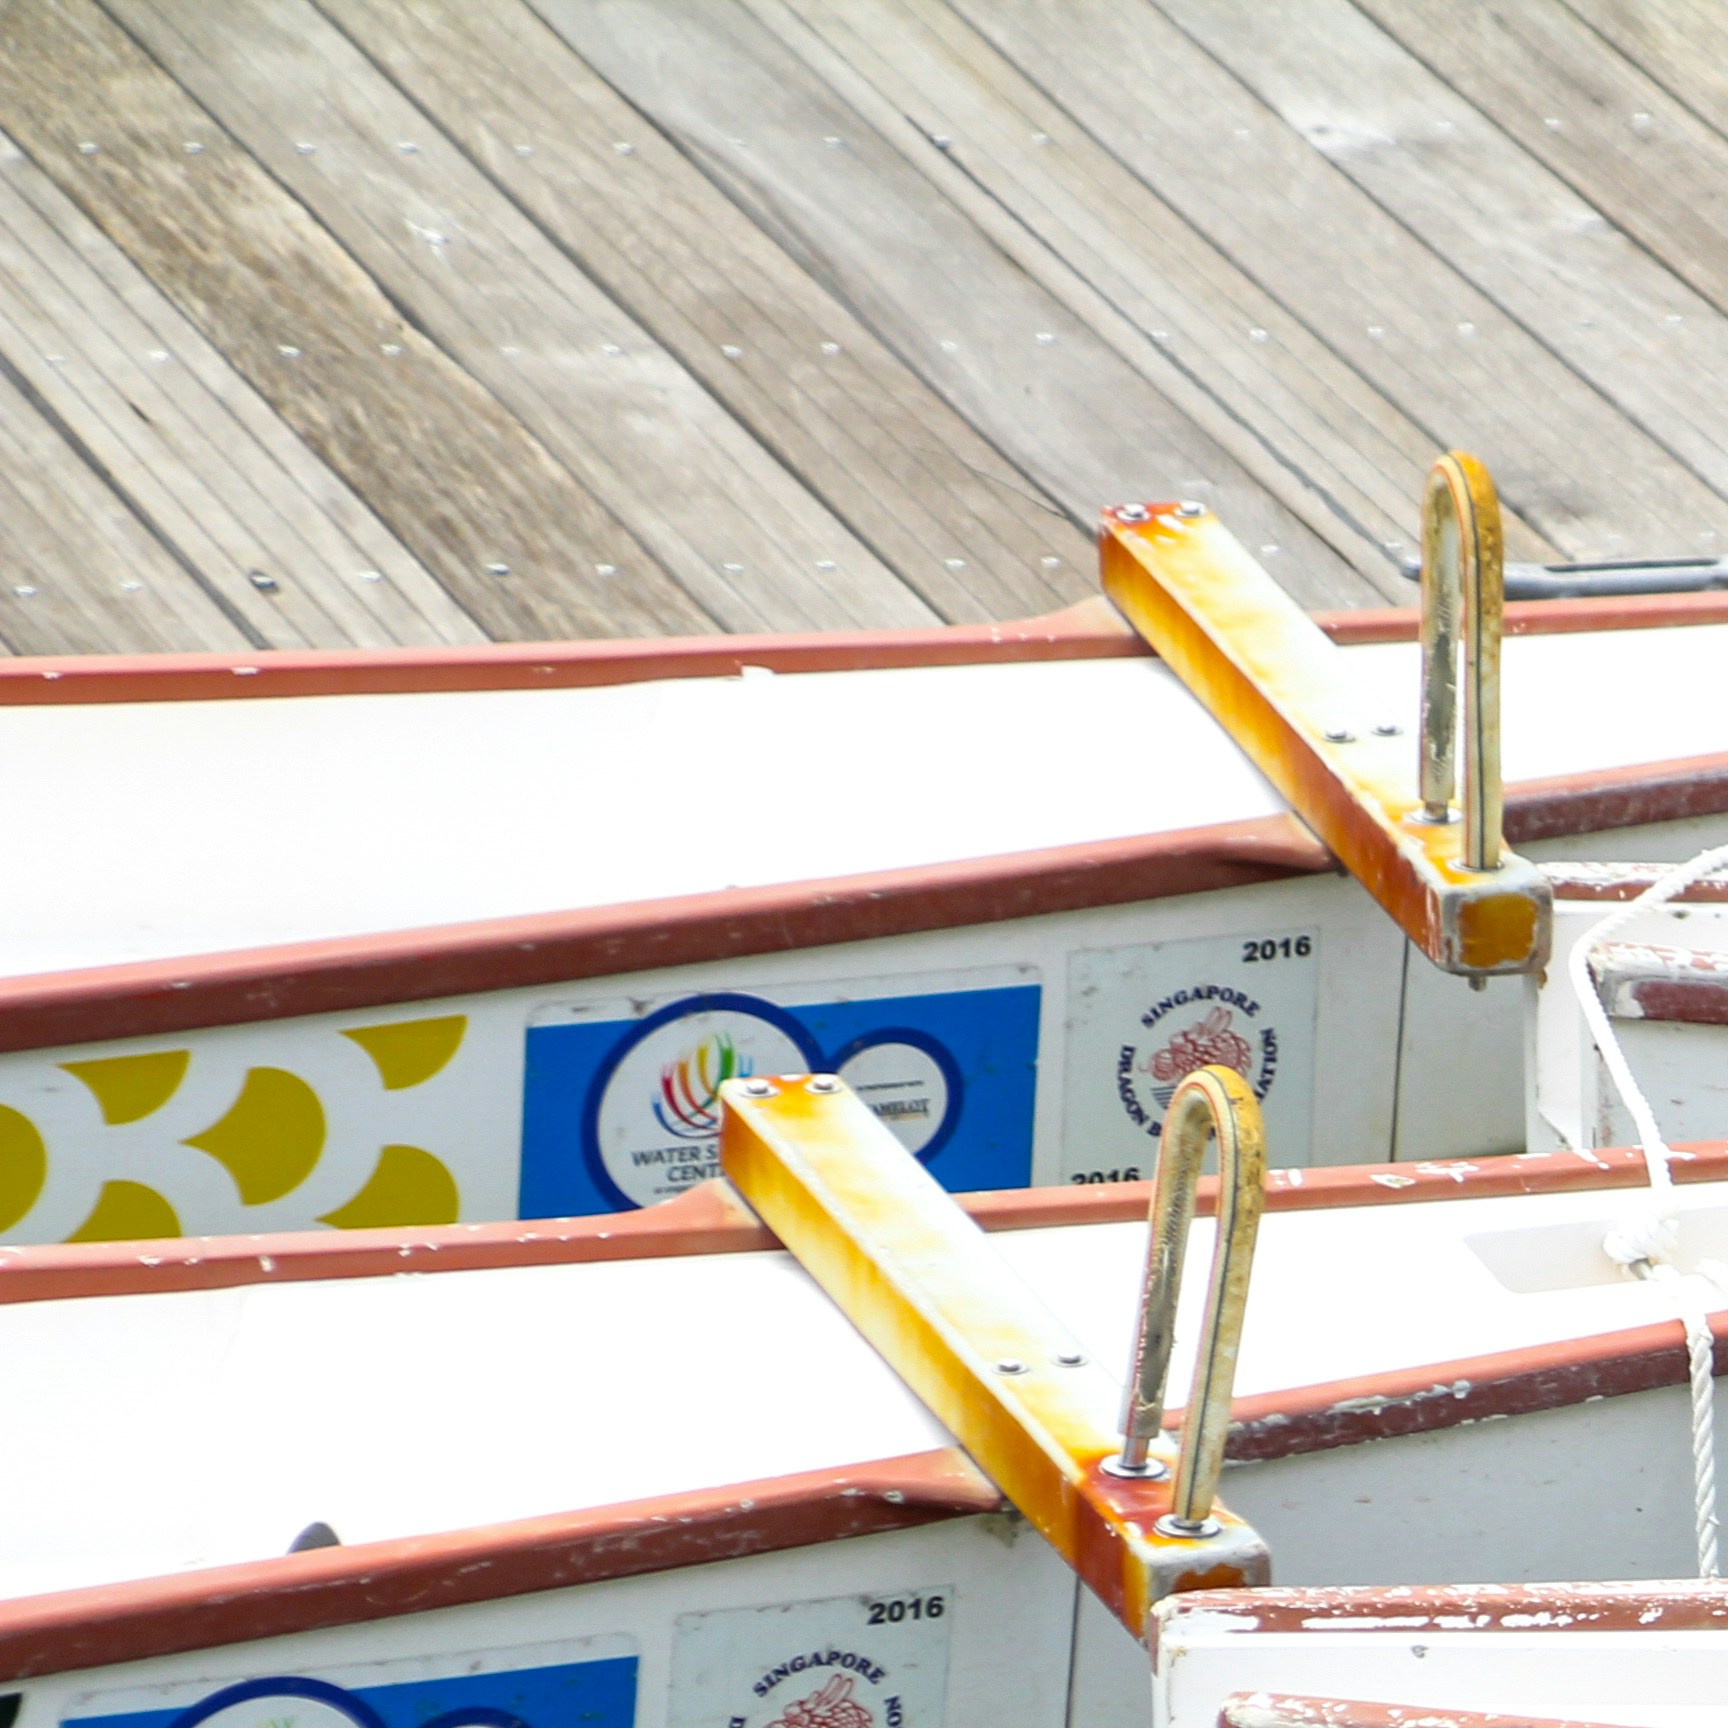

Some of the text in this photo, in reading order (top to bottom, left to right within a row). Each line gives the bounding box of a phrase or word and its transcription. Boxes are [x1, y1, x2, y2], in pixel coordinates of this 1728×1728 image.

[1242, 935, 1312, 962] 2016
[1140, 984, 1261, 1029] SINGAPORE
[1117, 1044, 1150, 1127] DRAGON
[632, 1145, 700, 1167] WATER
[867, 1596, 944, 1625] 2016
[753, 1650, 886, 1698] SINGAPORE
